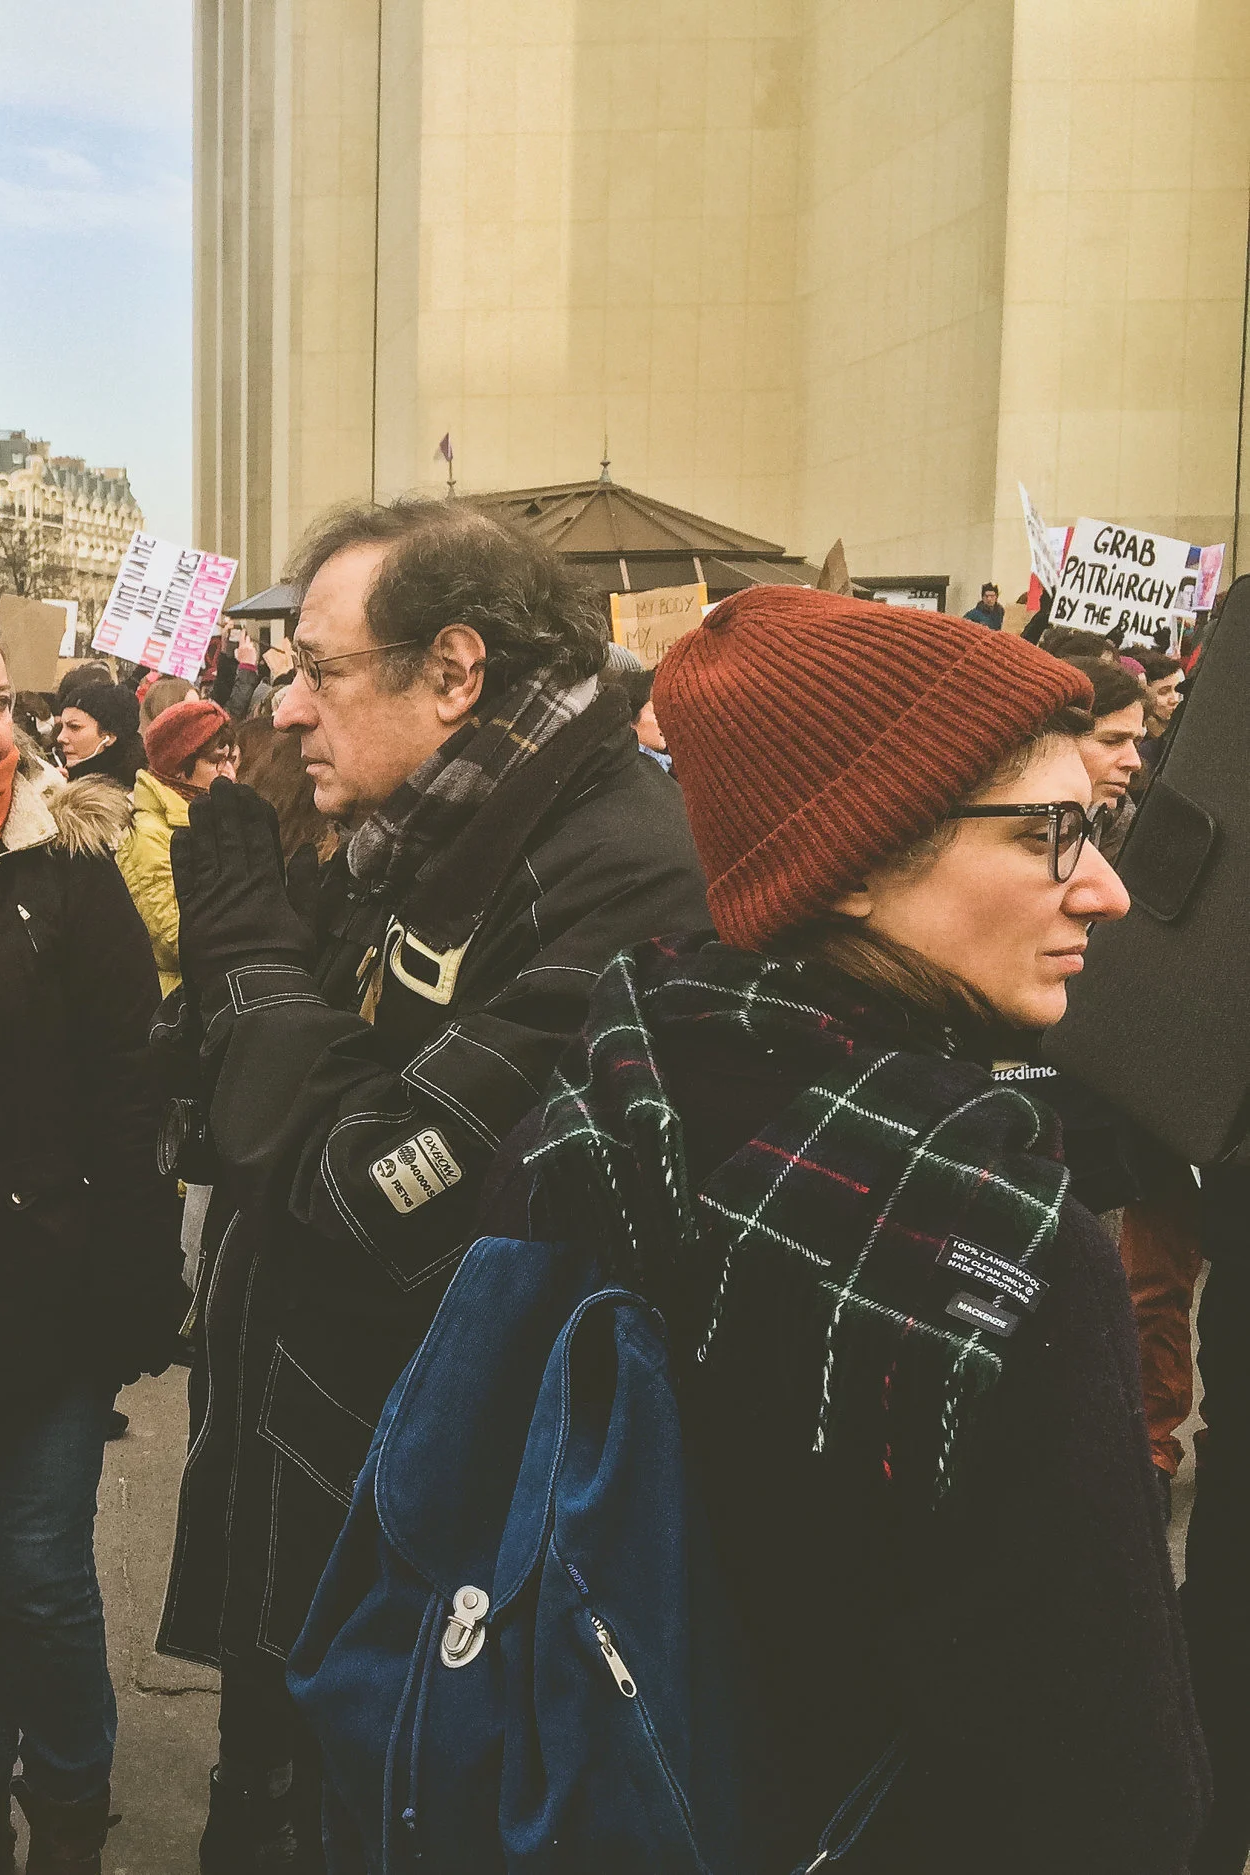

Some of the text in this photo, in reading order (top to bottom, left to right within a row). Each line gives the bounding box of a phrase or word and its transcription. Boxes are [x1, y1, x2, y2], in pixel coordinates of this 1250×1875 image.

[1093, 526, 1156, 566] GRAB
[169, 550, 201, 590] TAXES
[190, 553, 236, 606] POWER
[95, 620, 123, 651] NOT
[123, 535, 157, 583] NAME
[134, 585, 162, 619] AND
[636, 600, 654, 617] MY
[1054, 595, 1079, 621] BY
[1084, 602, 1112, 626] THE
[151, 604, 181, 638] WITH
[626, 627, 651, 650] MY
[139, 636, 167, 669] NOT
[423, 1135, 458, 1178] OXBOW
[947, 1260, 1030, 1304] MADE IN SCOTLAND
[952, 1252, 1025, 1290] DRY CLEAN ONLY
[953, 1240, 1041, 1291] 100% LAMBSWOOL
[957, 1301, 1009, 1329] MACKENZIE
